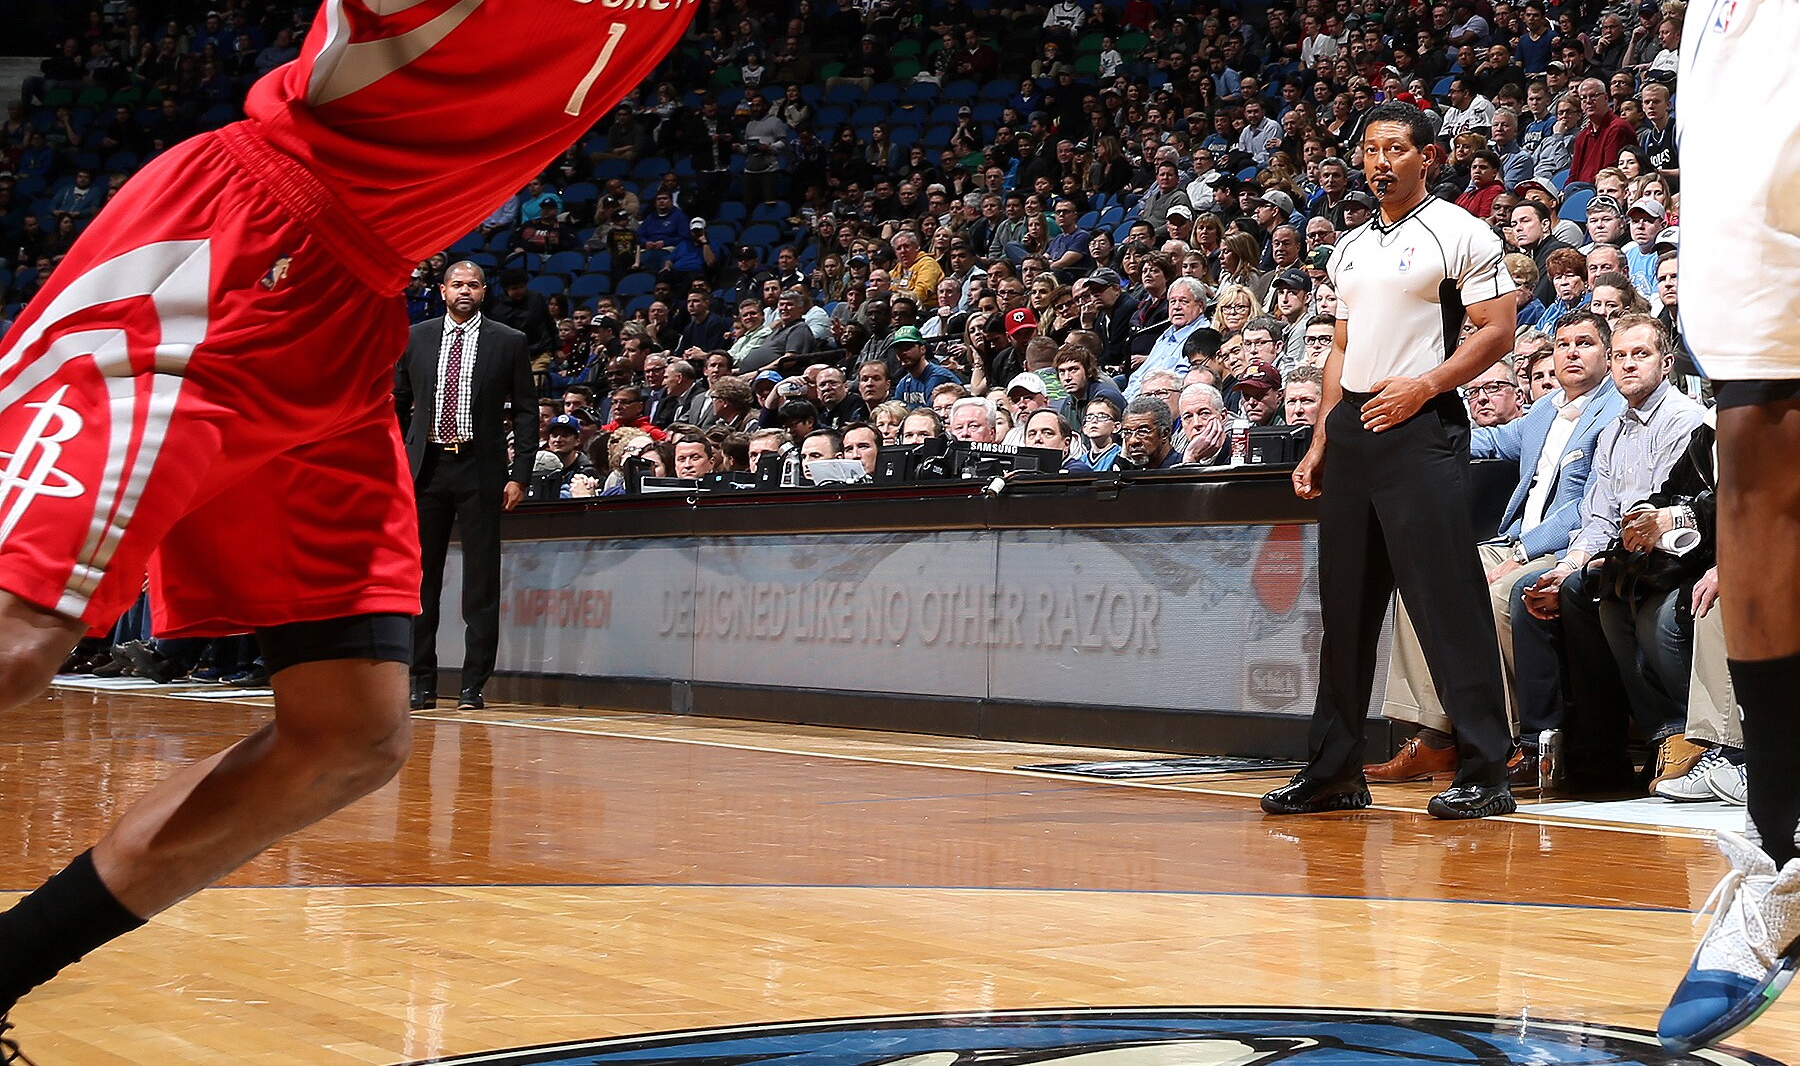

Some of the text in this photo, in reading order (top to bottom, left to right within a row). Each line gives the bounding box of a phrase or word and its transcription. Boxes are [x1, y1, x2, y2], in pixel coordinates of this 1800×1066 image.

[564, 21, 628, 117] 1
[970, 441, 1018, 454] SAMSUNG
[862, 585, 912, 645] NO
[920, 585, 1025, 647] OTHER
[1036, 585, 1163, 654] RAZOR
